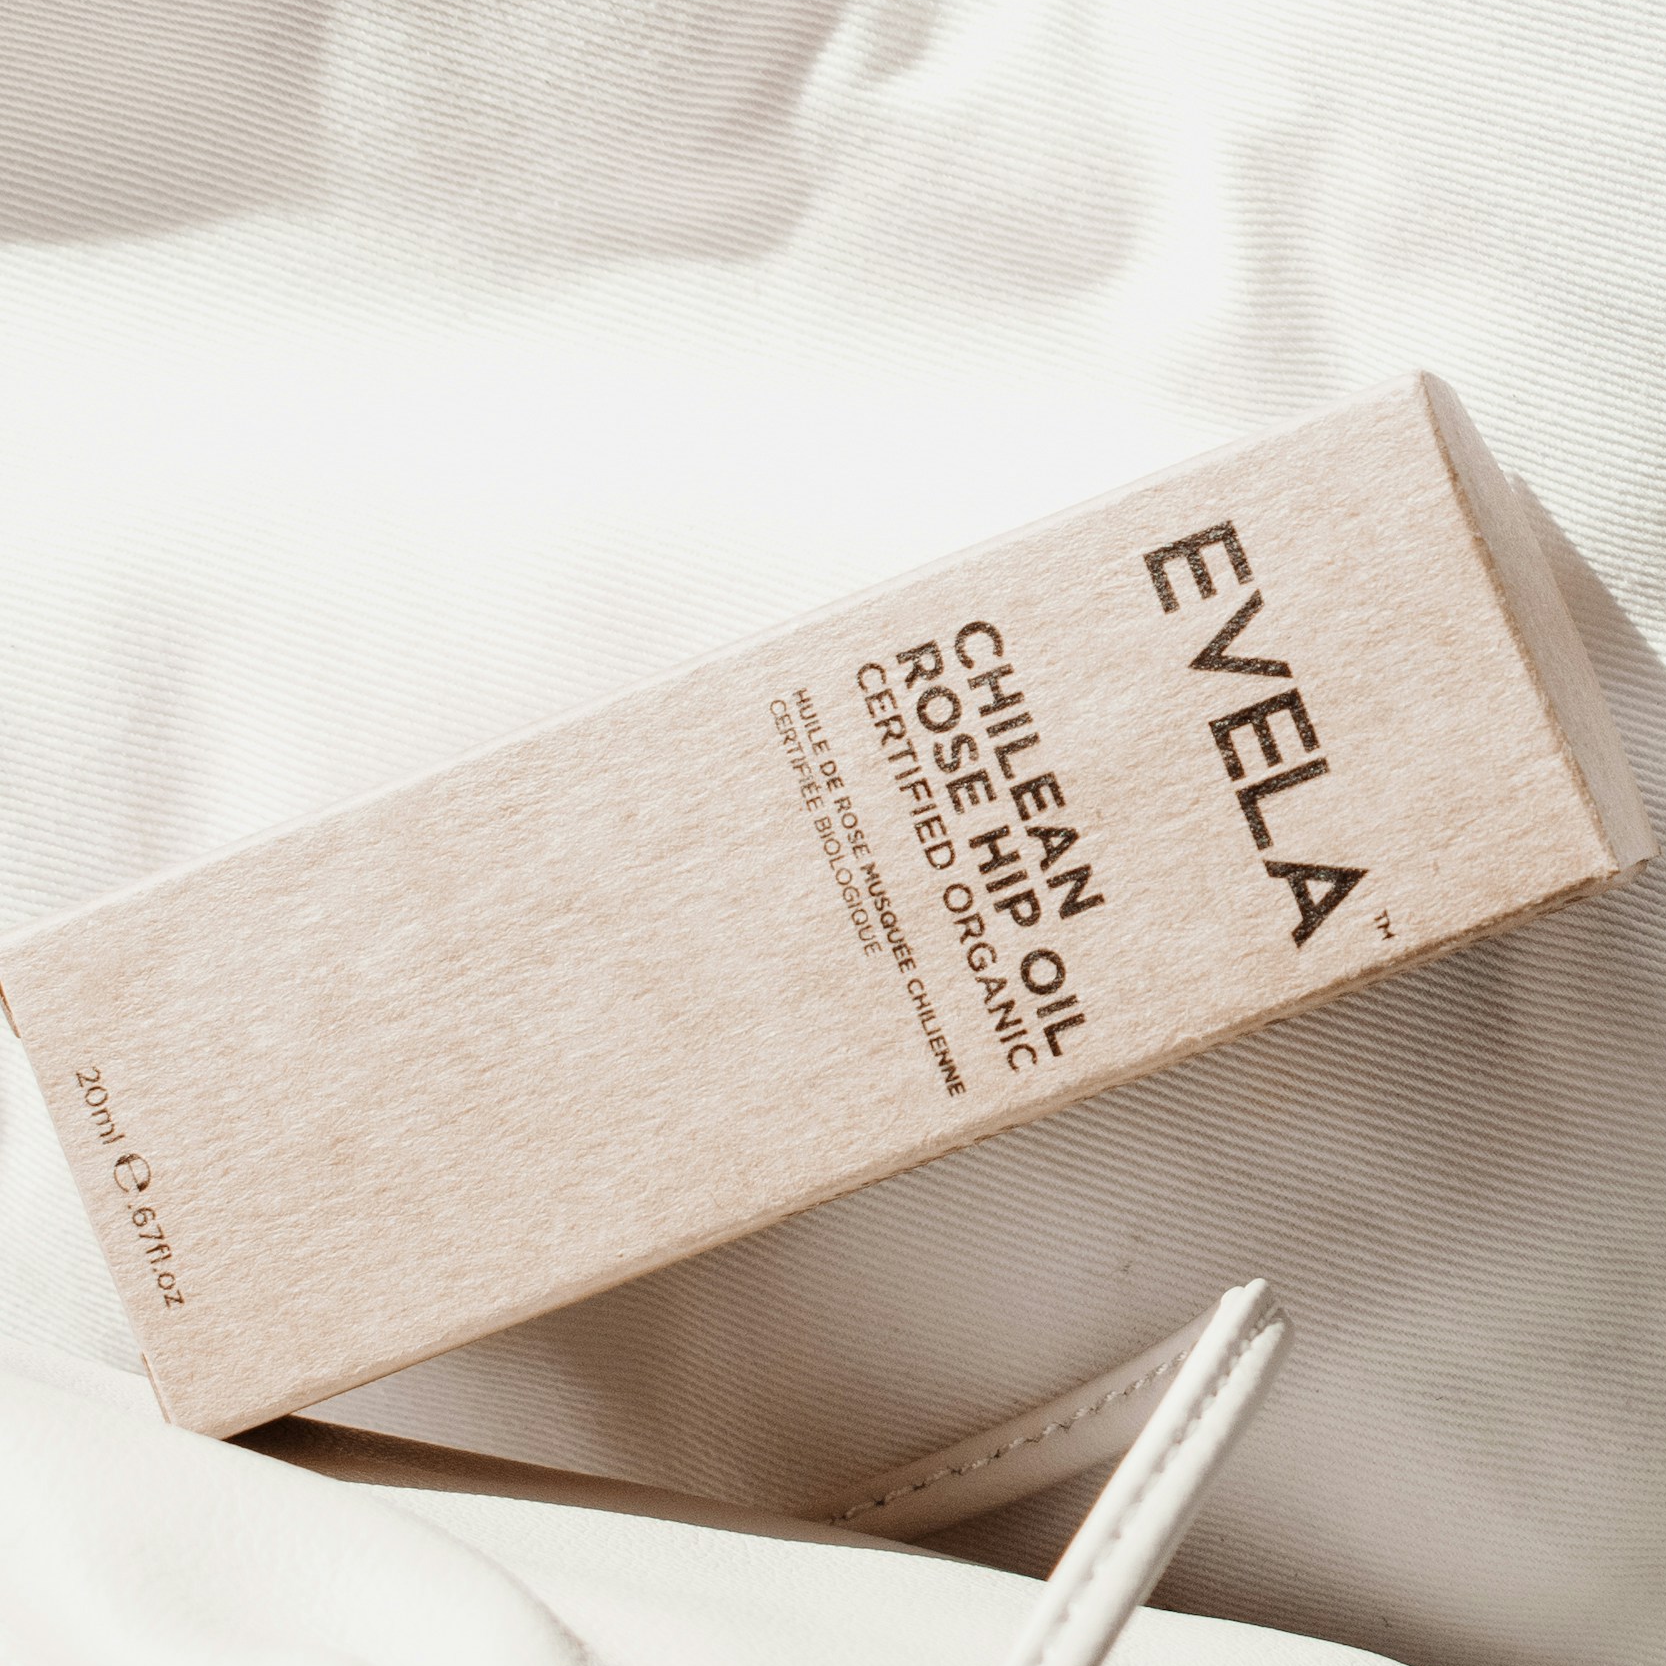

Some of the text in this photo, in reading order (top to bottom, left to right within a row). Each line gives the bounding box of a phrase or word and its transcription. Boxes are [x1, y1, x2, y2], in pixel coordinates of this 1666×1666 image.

[769, 699, 883, 958] CERTIFIÉE BIOLOGIQUE
[792, 688, 966, 1098] HUILE DE ROSE MUSQUÉE CHILIENNE
[856, 662, 1038, 1072] CERTIFIED ORGANIC
[896, 640, 1086, 1057] ROSE HIP OIL
[954, 620, 1105, 920] CHILEAN
[1143, 520, 1369, 949] EVELA
[75, 1066, 126, 1145] 20ml
